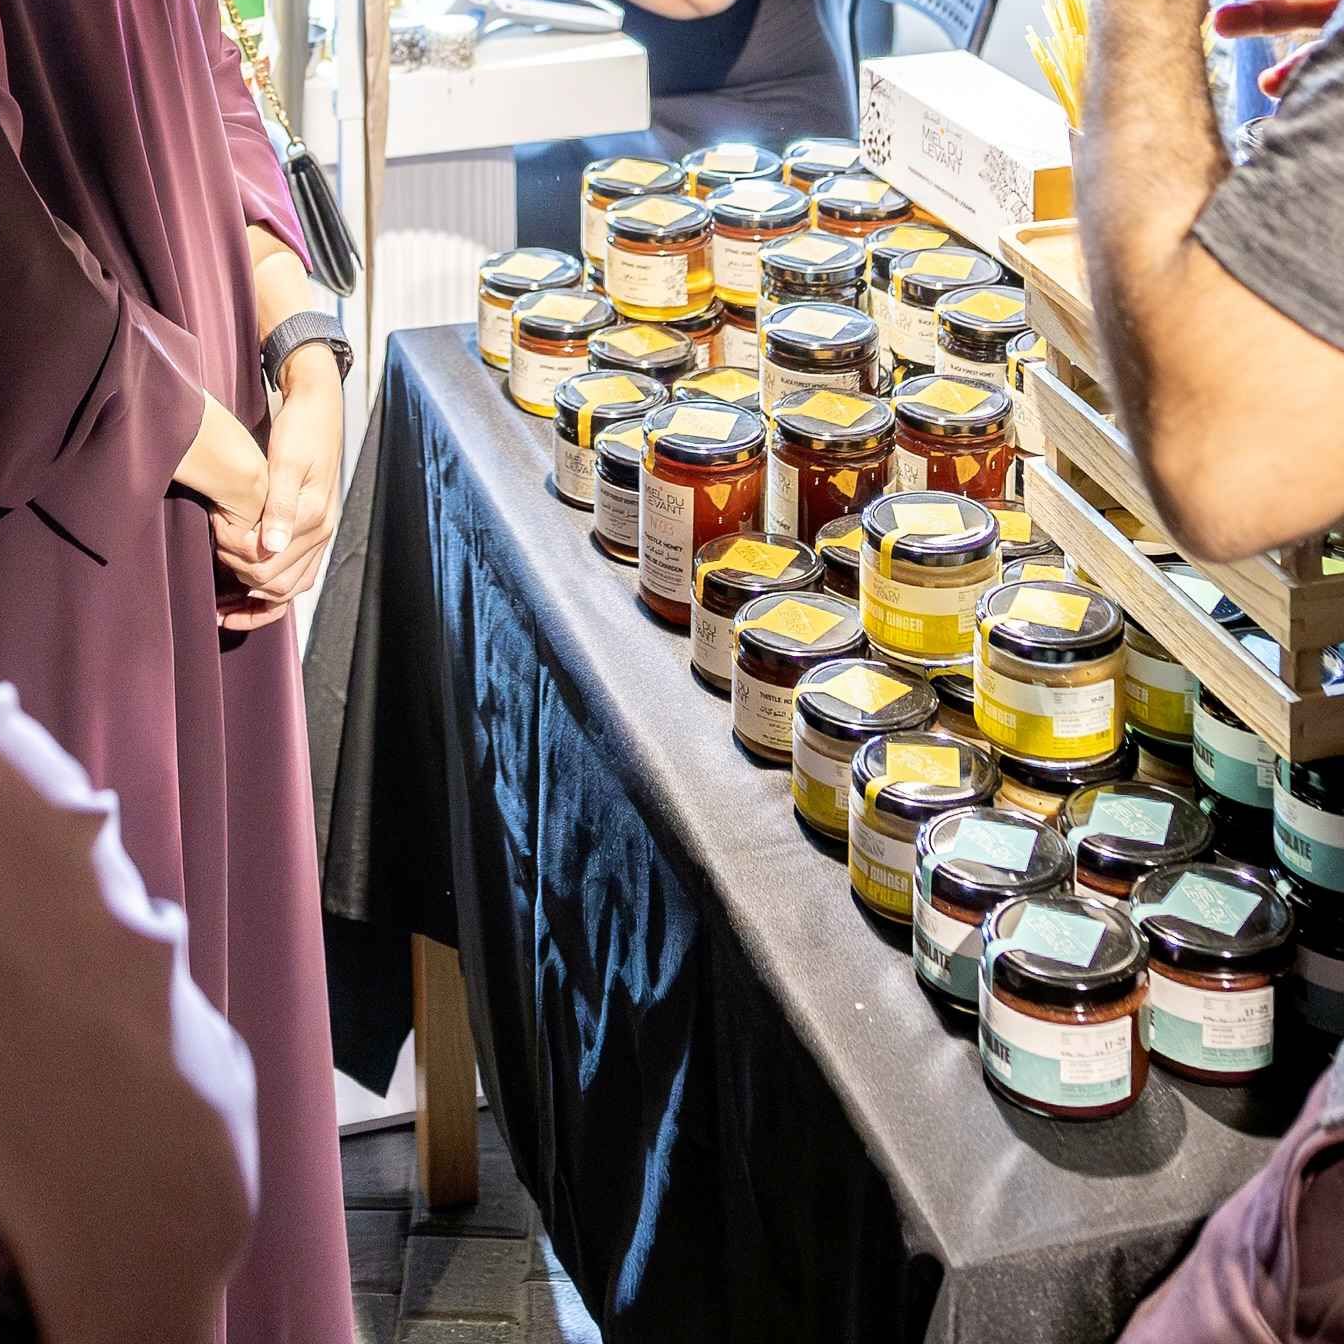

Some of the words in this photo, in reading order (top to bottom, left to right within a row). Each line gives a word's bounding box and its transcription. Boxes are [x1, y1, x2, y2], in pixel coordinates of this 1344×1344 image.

[921, 138, 963, 176] LEVANT
[647, 496, 685, 516] EVANT
[666, 494, 685, 507] DU
[759, 690, 782, 703] THISTLE
